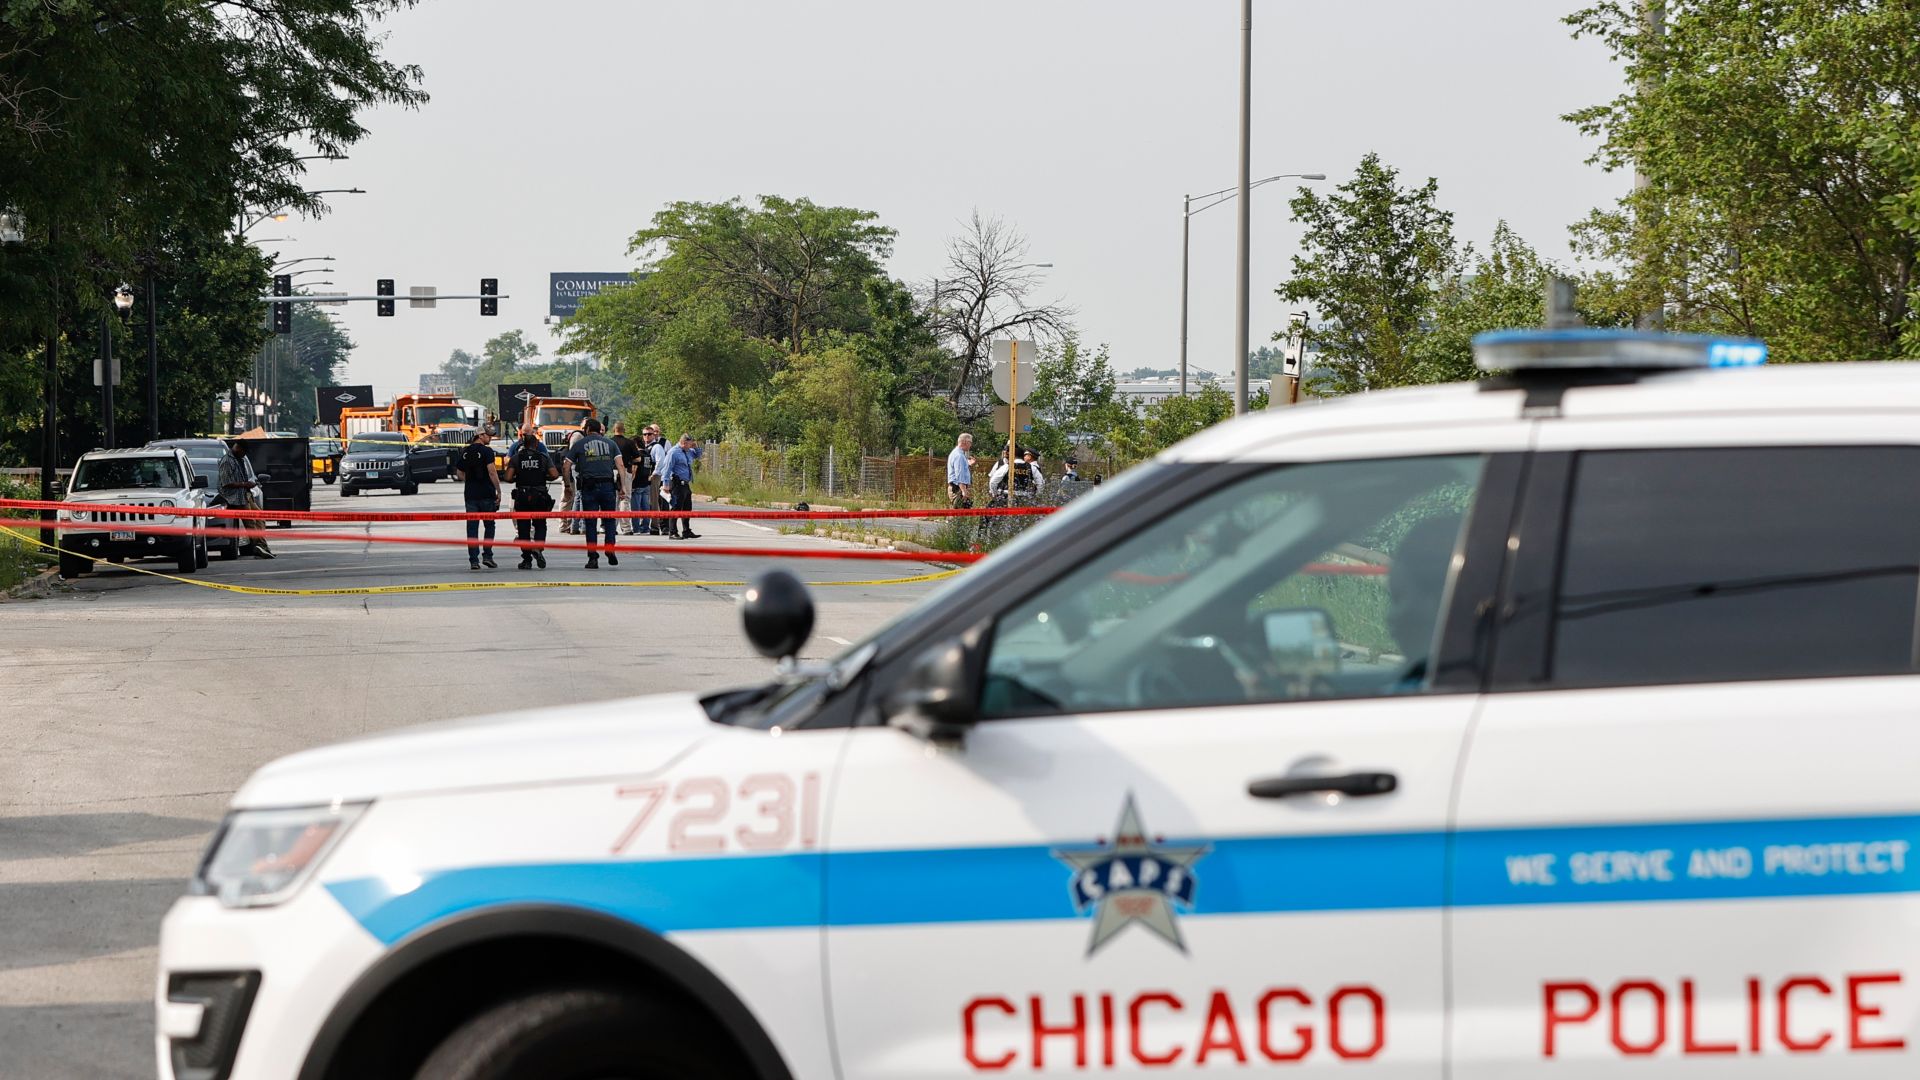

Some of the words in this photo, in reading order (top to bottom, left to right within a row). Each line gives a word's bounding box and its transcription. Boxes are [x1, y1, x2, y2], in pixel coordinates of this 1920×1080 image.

[521, 459, 540, 469] POLICE
[611, 770, 820, 855] 7231
[1081, 858, 1185, 899] CAPS
[1505, 853, 1557, 885] WE
[1569, 849, 1674, 884] SERVE
[1687, 846, 1753, 879] AND
[1763, 840, 1909, 875] PROTECT
[961, 984, 1387, 1071] CHICAGO
[1541, 969, 1906, 1058] POLICE
